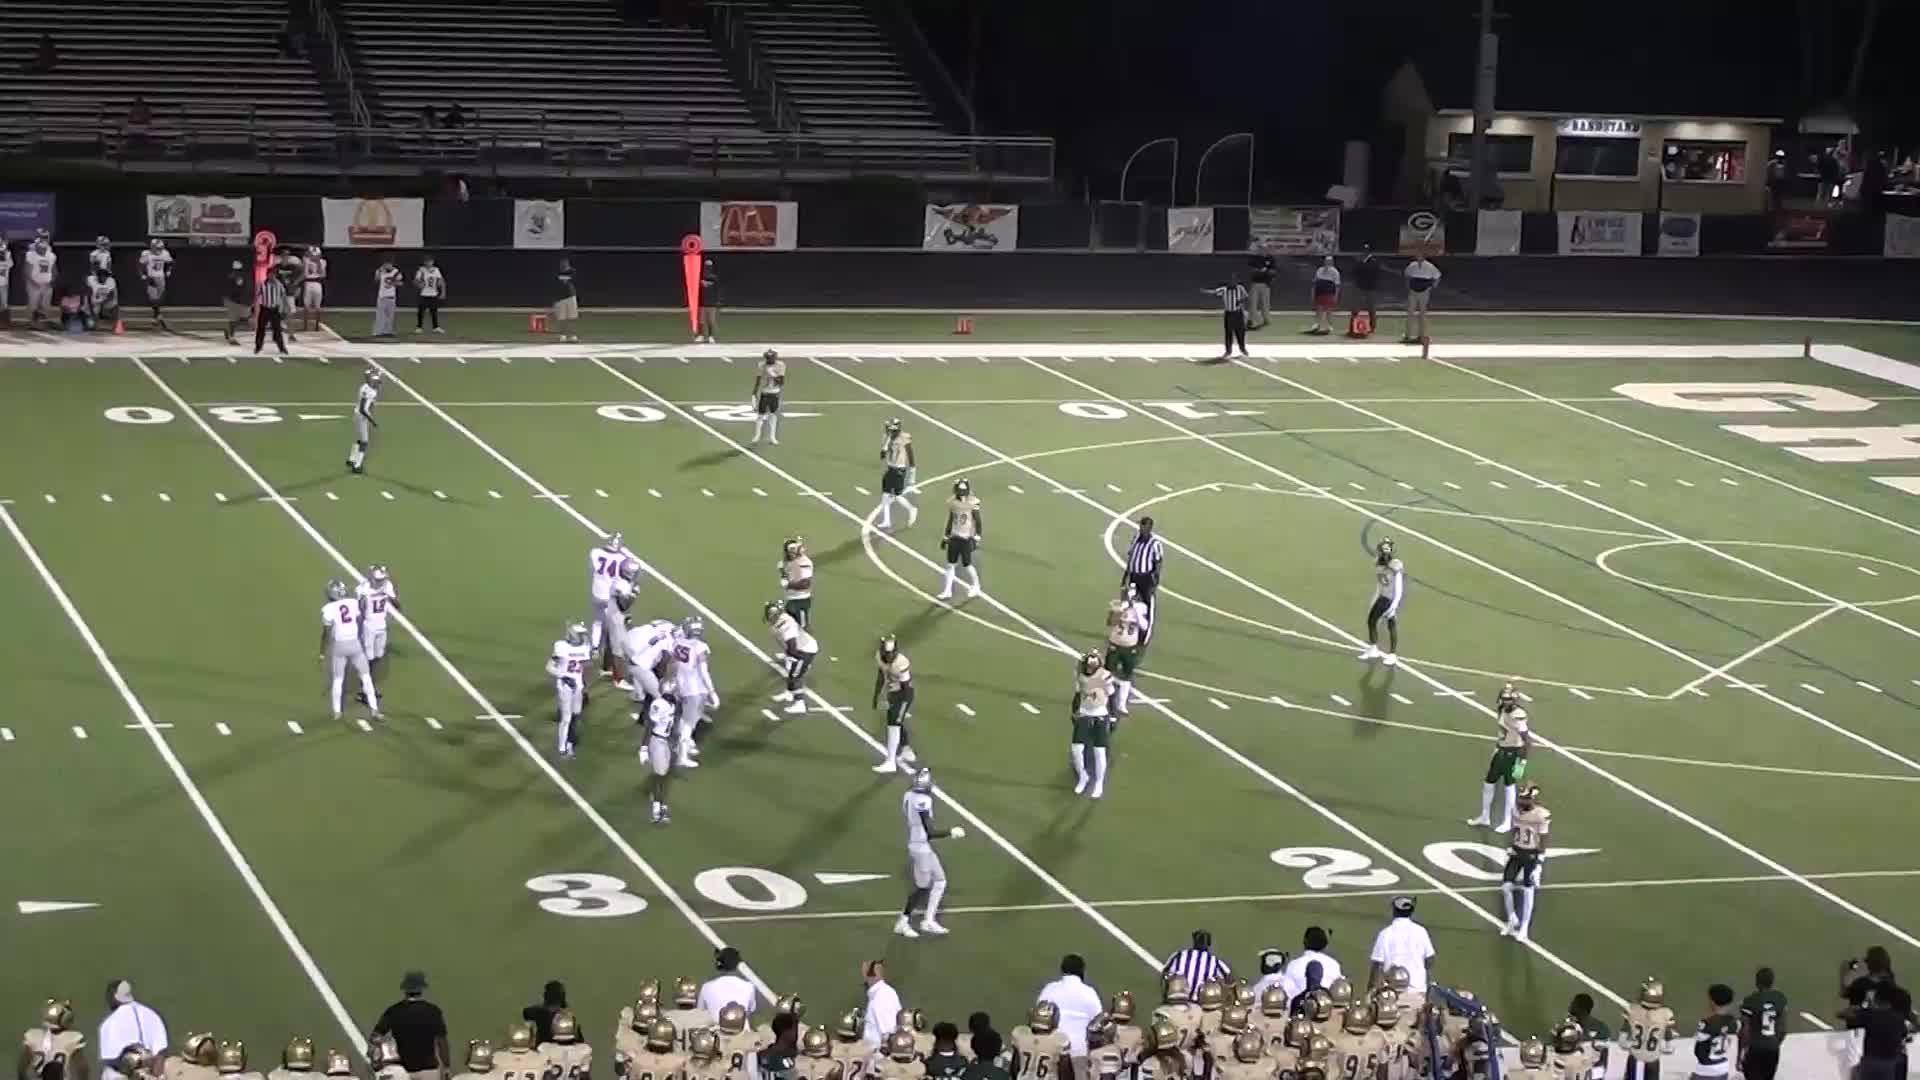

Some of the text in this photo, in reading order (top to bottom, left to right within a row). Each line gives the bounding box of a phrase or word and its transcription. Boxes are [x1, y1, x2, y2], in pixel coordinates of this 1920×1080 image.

[1572, 119, 1640, 132] BANDSTAND
[339, 604, 352, 624] 2
[524, 866, 807, 917] 30
[1761, 1010, 1777, 1034] 5
[1631, 1024, 1660, 1051] 36
[1022, 1051, 1049, 1078] 76
